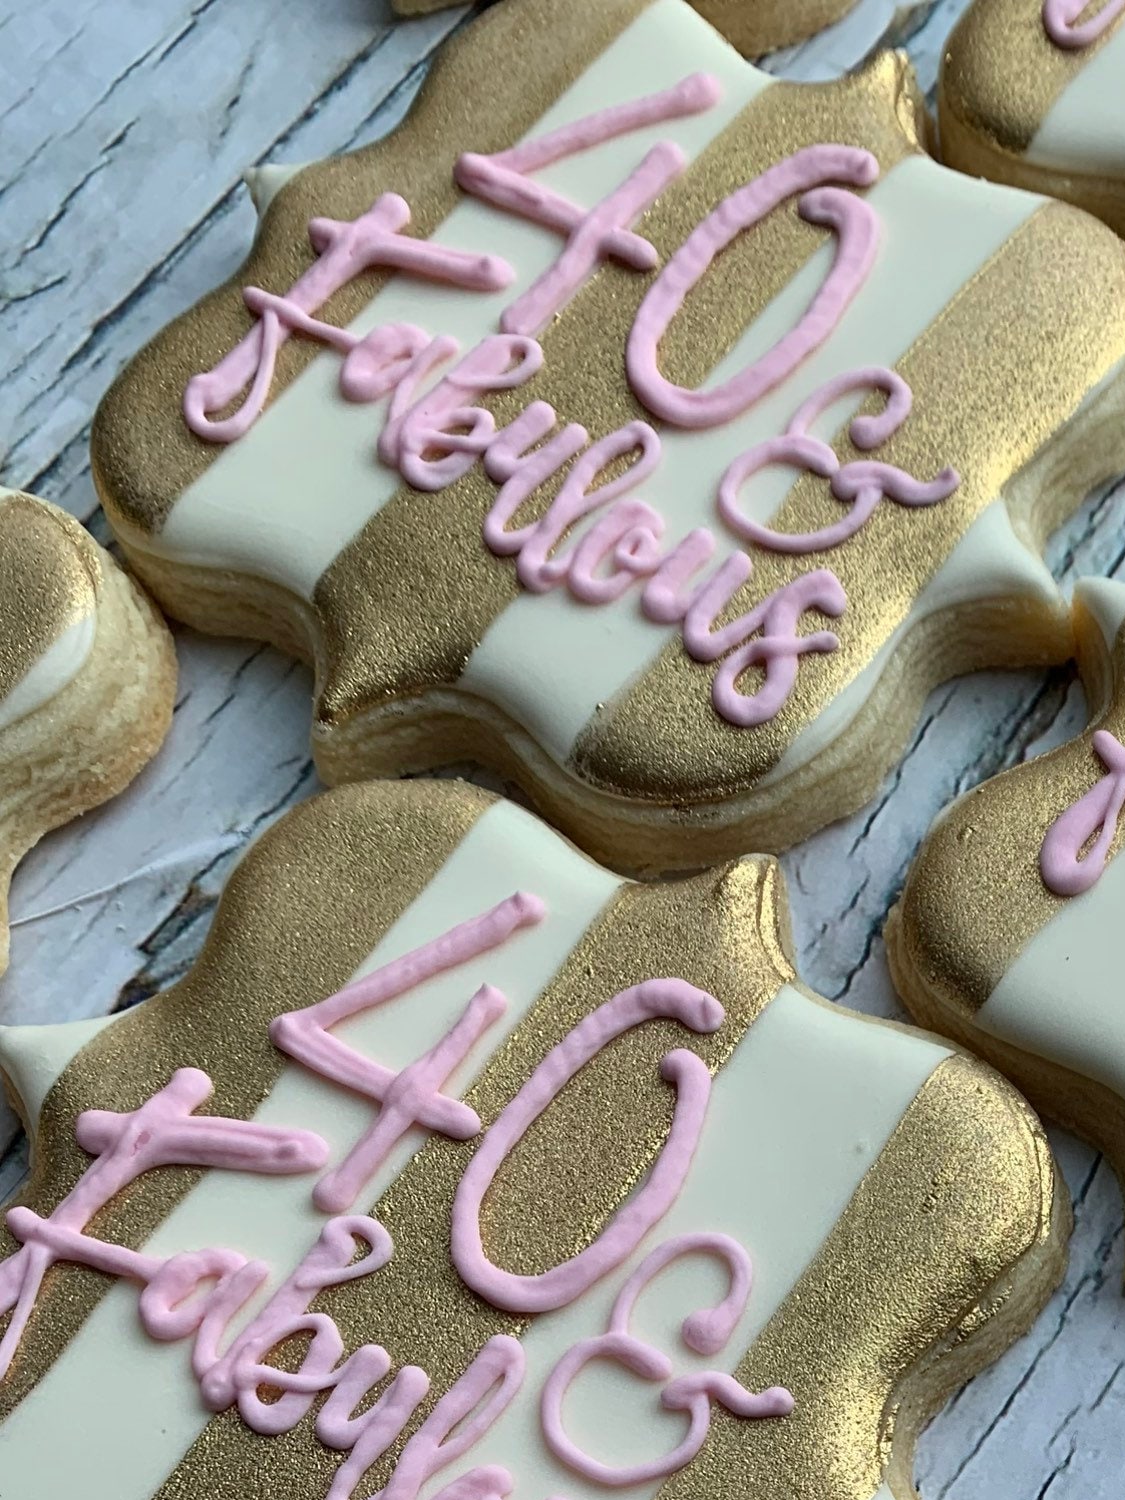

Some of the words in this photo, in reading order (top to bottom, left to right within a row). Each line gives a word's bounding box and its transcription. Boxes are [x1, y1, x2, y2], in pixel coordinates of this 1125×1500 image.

[183, 191, 849, 729] Fabulous
[453, 72, 880, 431] 40
[718, 366, 961, 553] &
[268, 890, 725, 1314] 40
[540, 1231, 795, 1488] &
